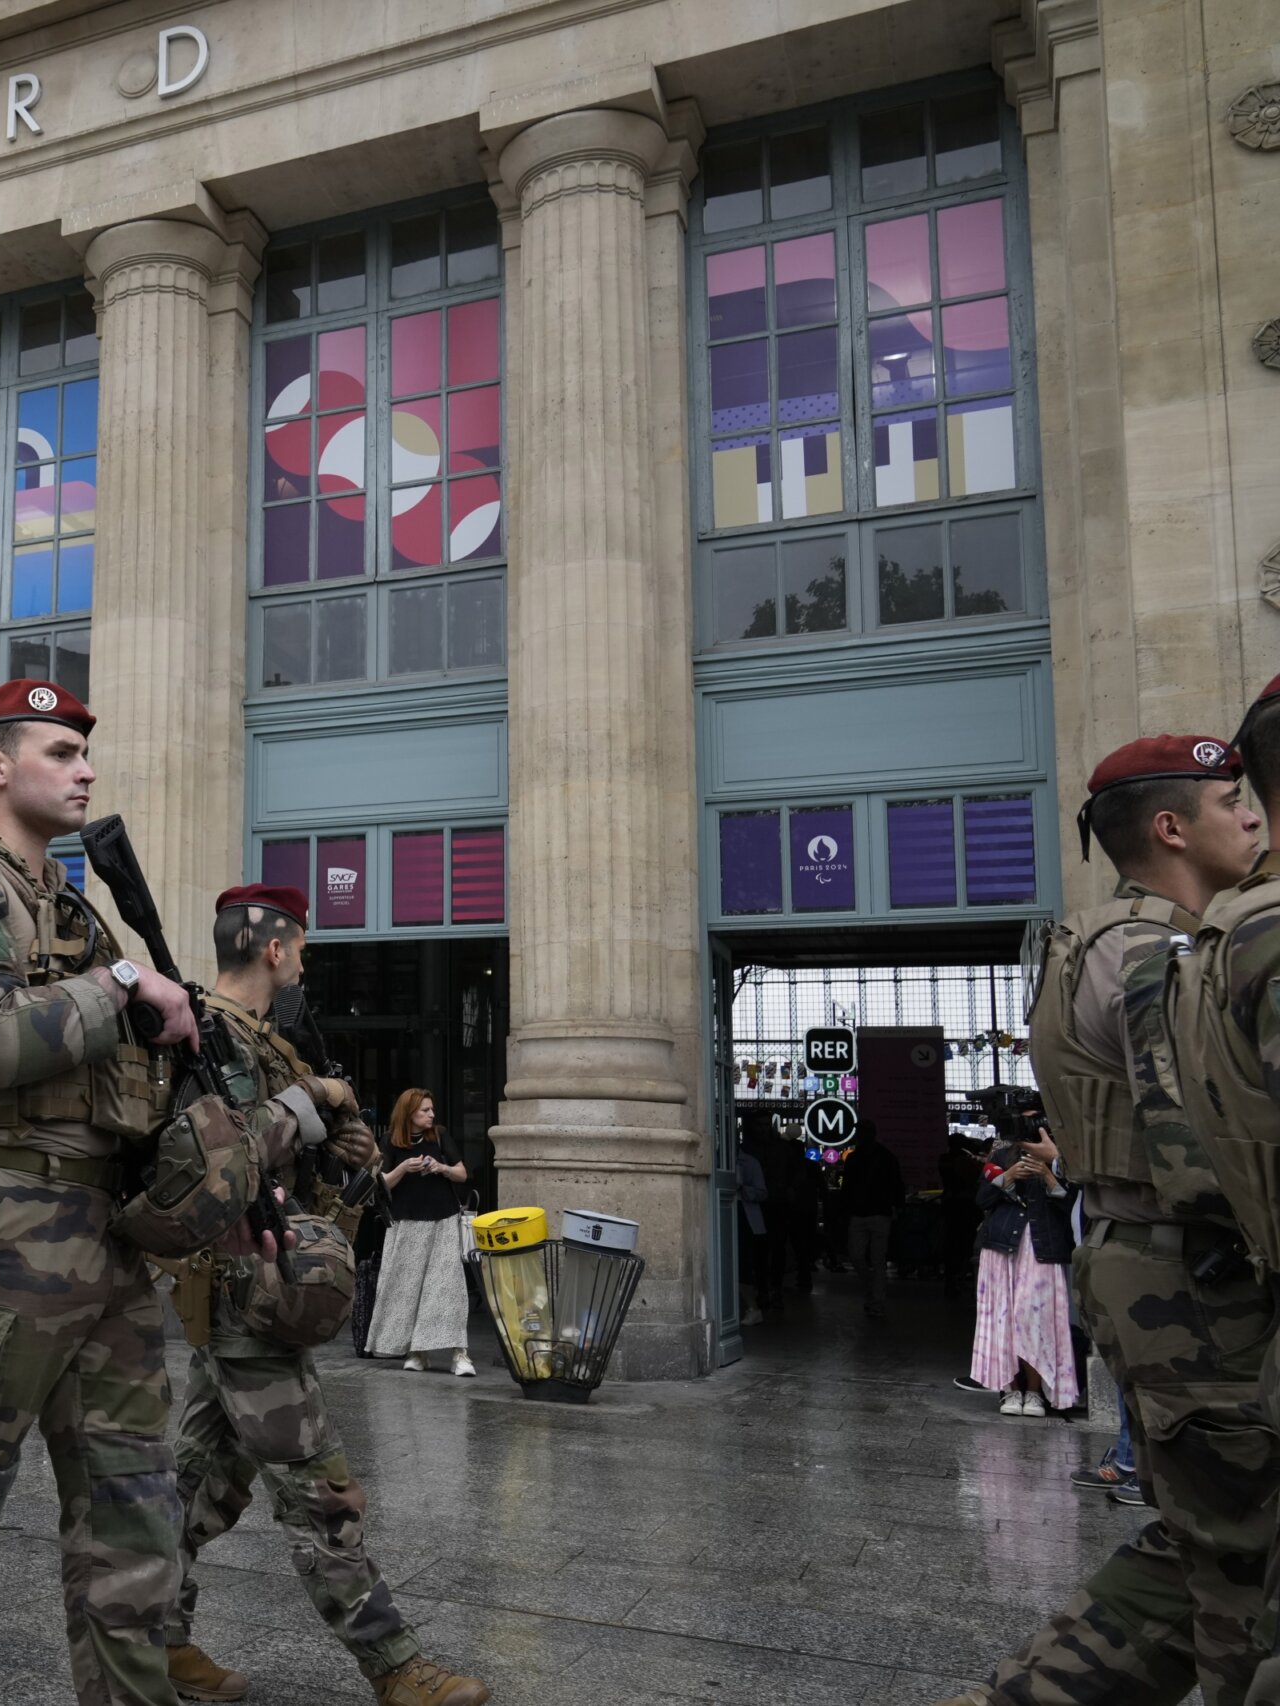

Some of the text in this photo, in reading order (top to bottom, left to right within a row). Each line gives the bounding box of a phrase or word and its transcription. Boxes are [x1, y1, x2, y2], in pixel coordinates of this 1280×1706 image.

[329, 873, 355, 882] SNCF
[810, 1041, 849, 1059] RER
[826, 1080, 835, 1088] D
[818, 1109, 843, 1134] M
